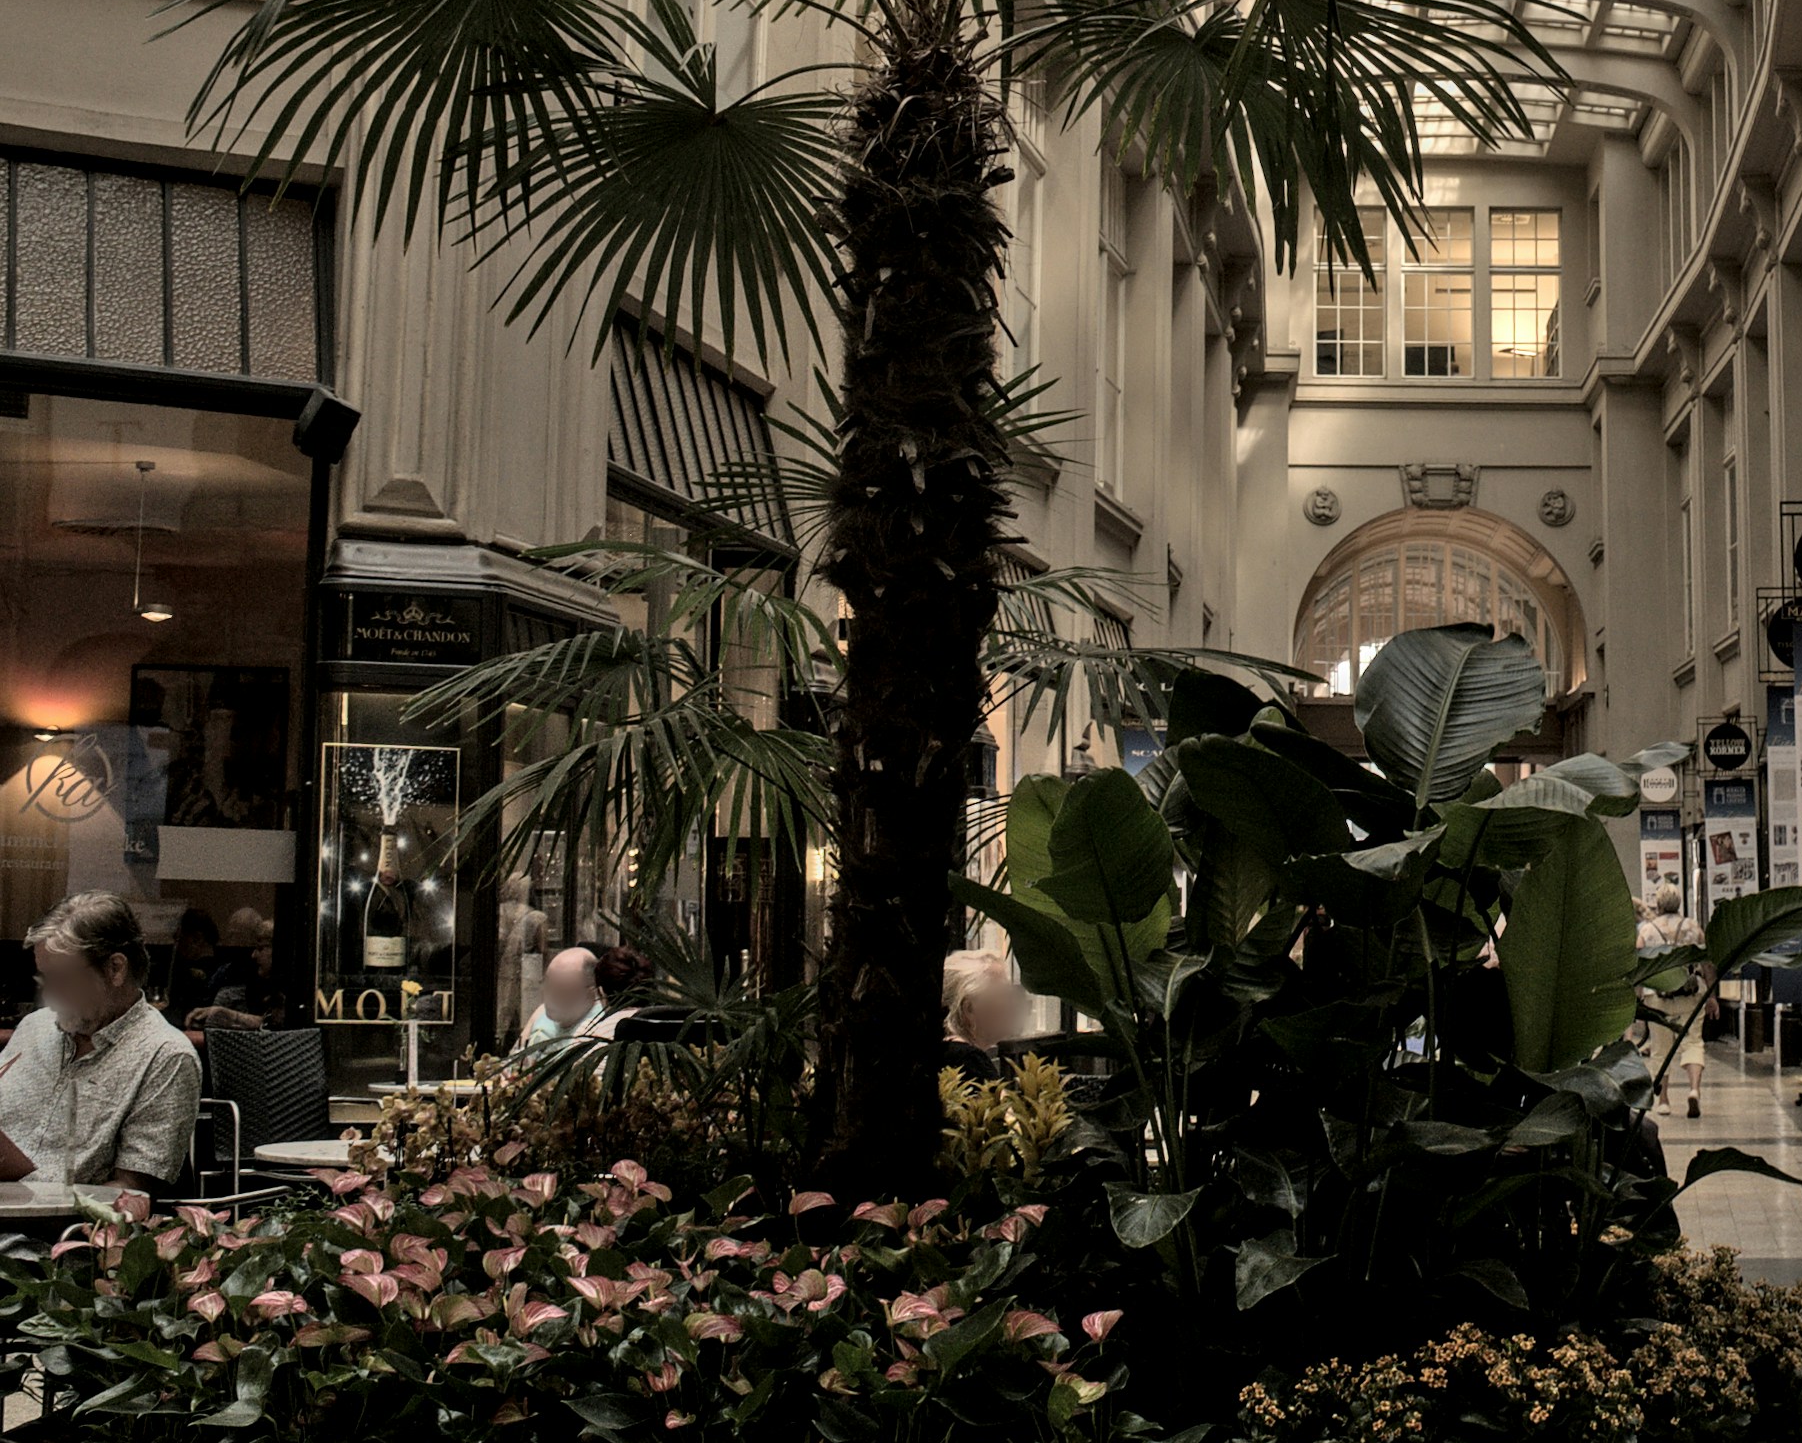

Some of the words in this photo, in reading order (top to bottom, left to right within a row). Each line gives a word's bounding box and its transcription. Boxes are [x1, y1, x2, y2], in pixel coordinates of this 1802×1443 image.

[403, 629, 471, 644] CHANDON
[1709, 738, 1746, 747] YELLOW
[1709, 746, 1747, 756] KORNER
